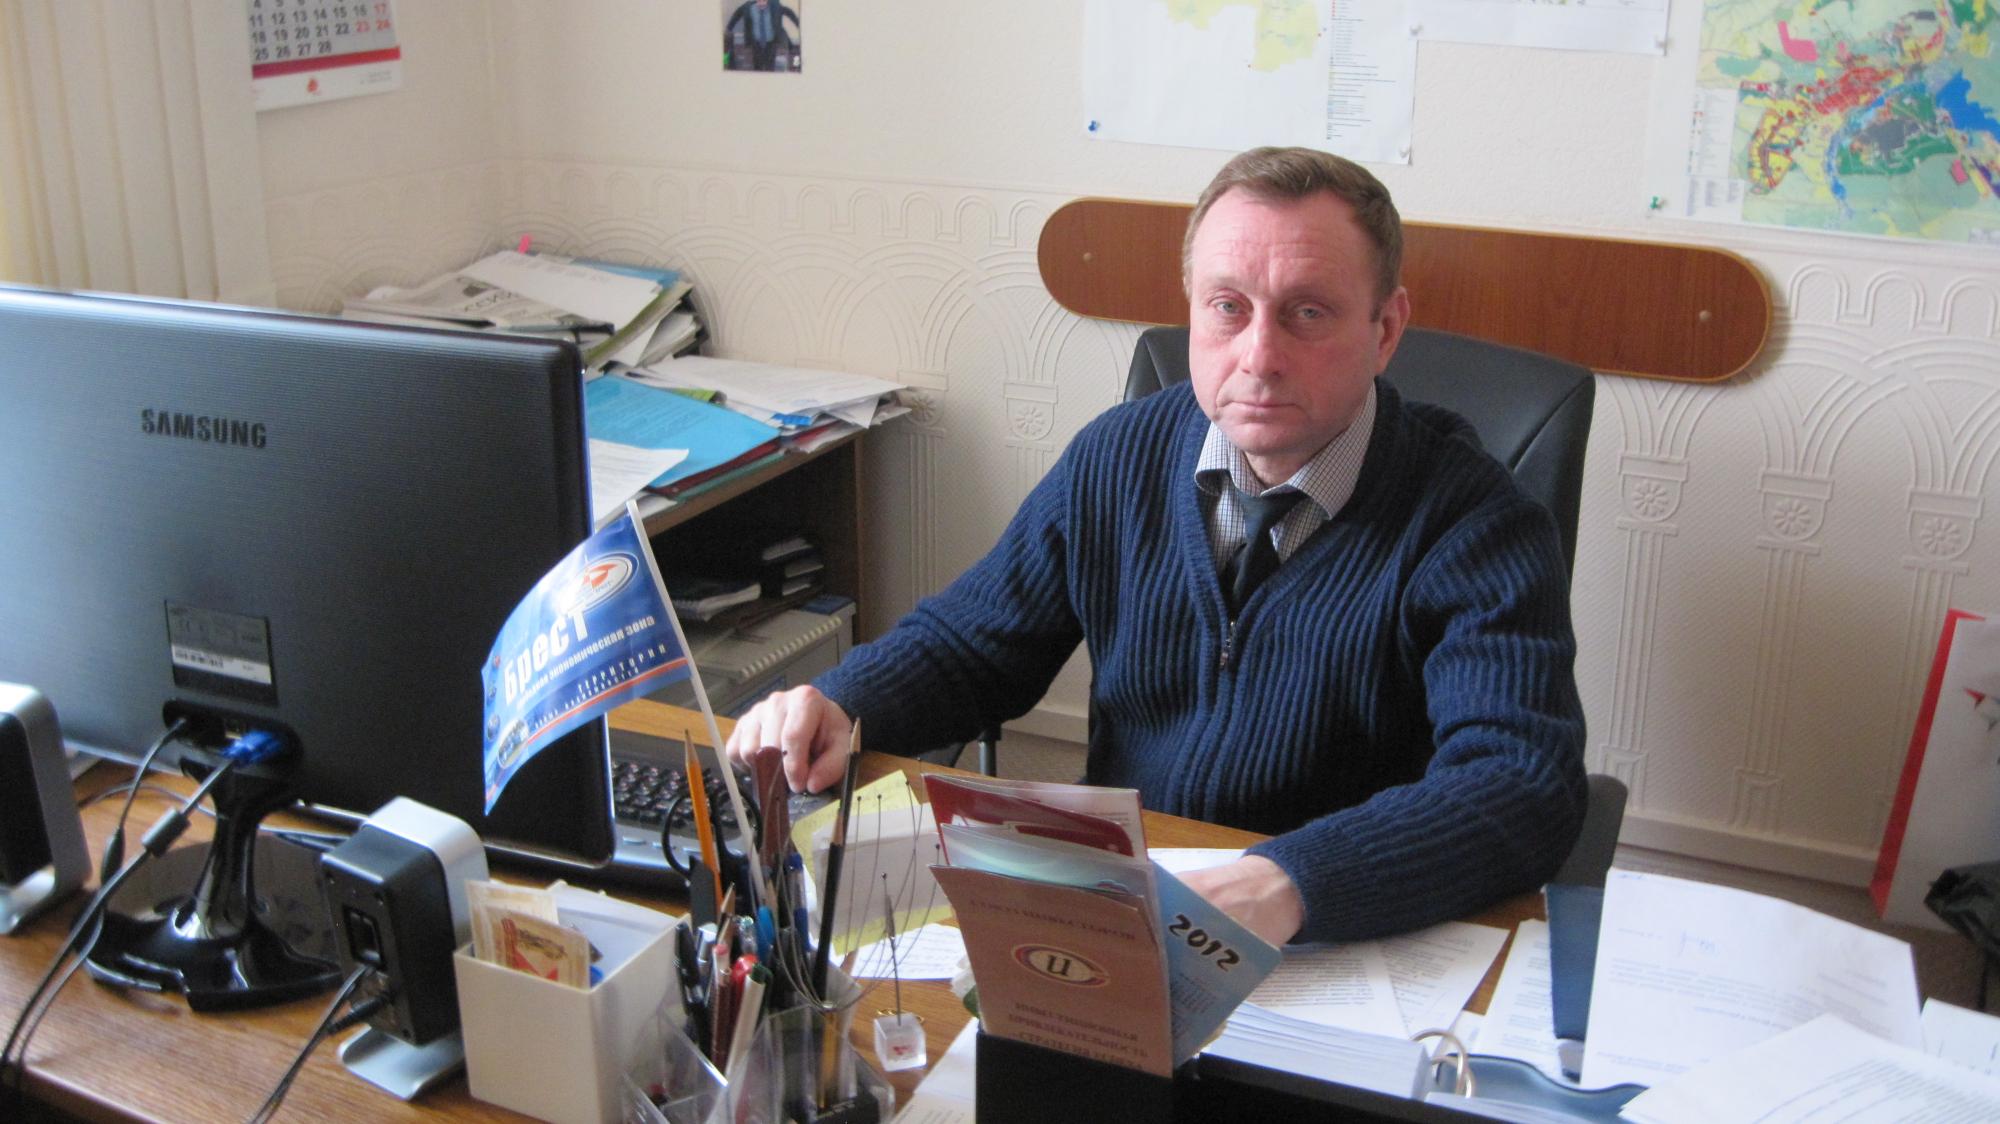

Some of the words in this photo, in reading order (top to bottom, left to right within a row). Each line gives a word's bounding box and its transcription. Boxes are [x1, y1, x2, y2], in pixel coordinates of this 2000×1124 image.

[249, 14, 263, 27] 11
[271, 12, 286, 25] 12
[293, 10, 307, 22] 13
[313, 8, 327, 20] 14
[333, 6, 347, 18] 15
[353, 4, 367, 16] 16
[374, 3, 387, 15] 17
[252, 31, 266, 43] 18
[274, 29, 288, 41] 19
[295, 26, 310, 39] 20
[316, 24, 329, 37] 21
[336, 22, 349, 35] 22
[356, 21, 370, 33] 23
[376, 19, 391, 31] 24
[254, 48, 269, 60] 25
[276, 45, 291, 58] 26
[297, 43, 311, 56] 27
[318, 41, 332, 53] 28
[141, 408, 267, 449] SAMSUNG
[1168, 913, 1241, 972] 2012
